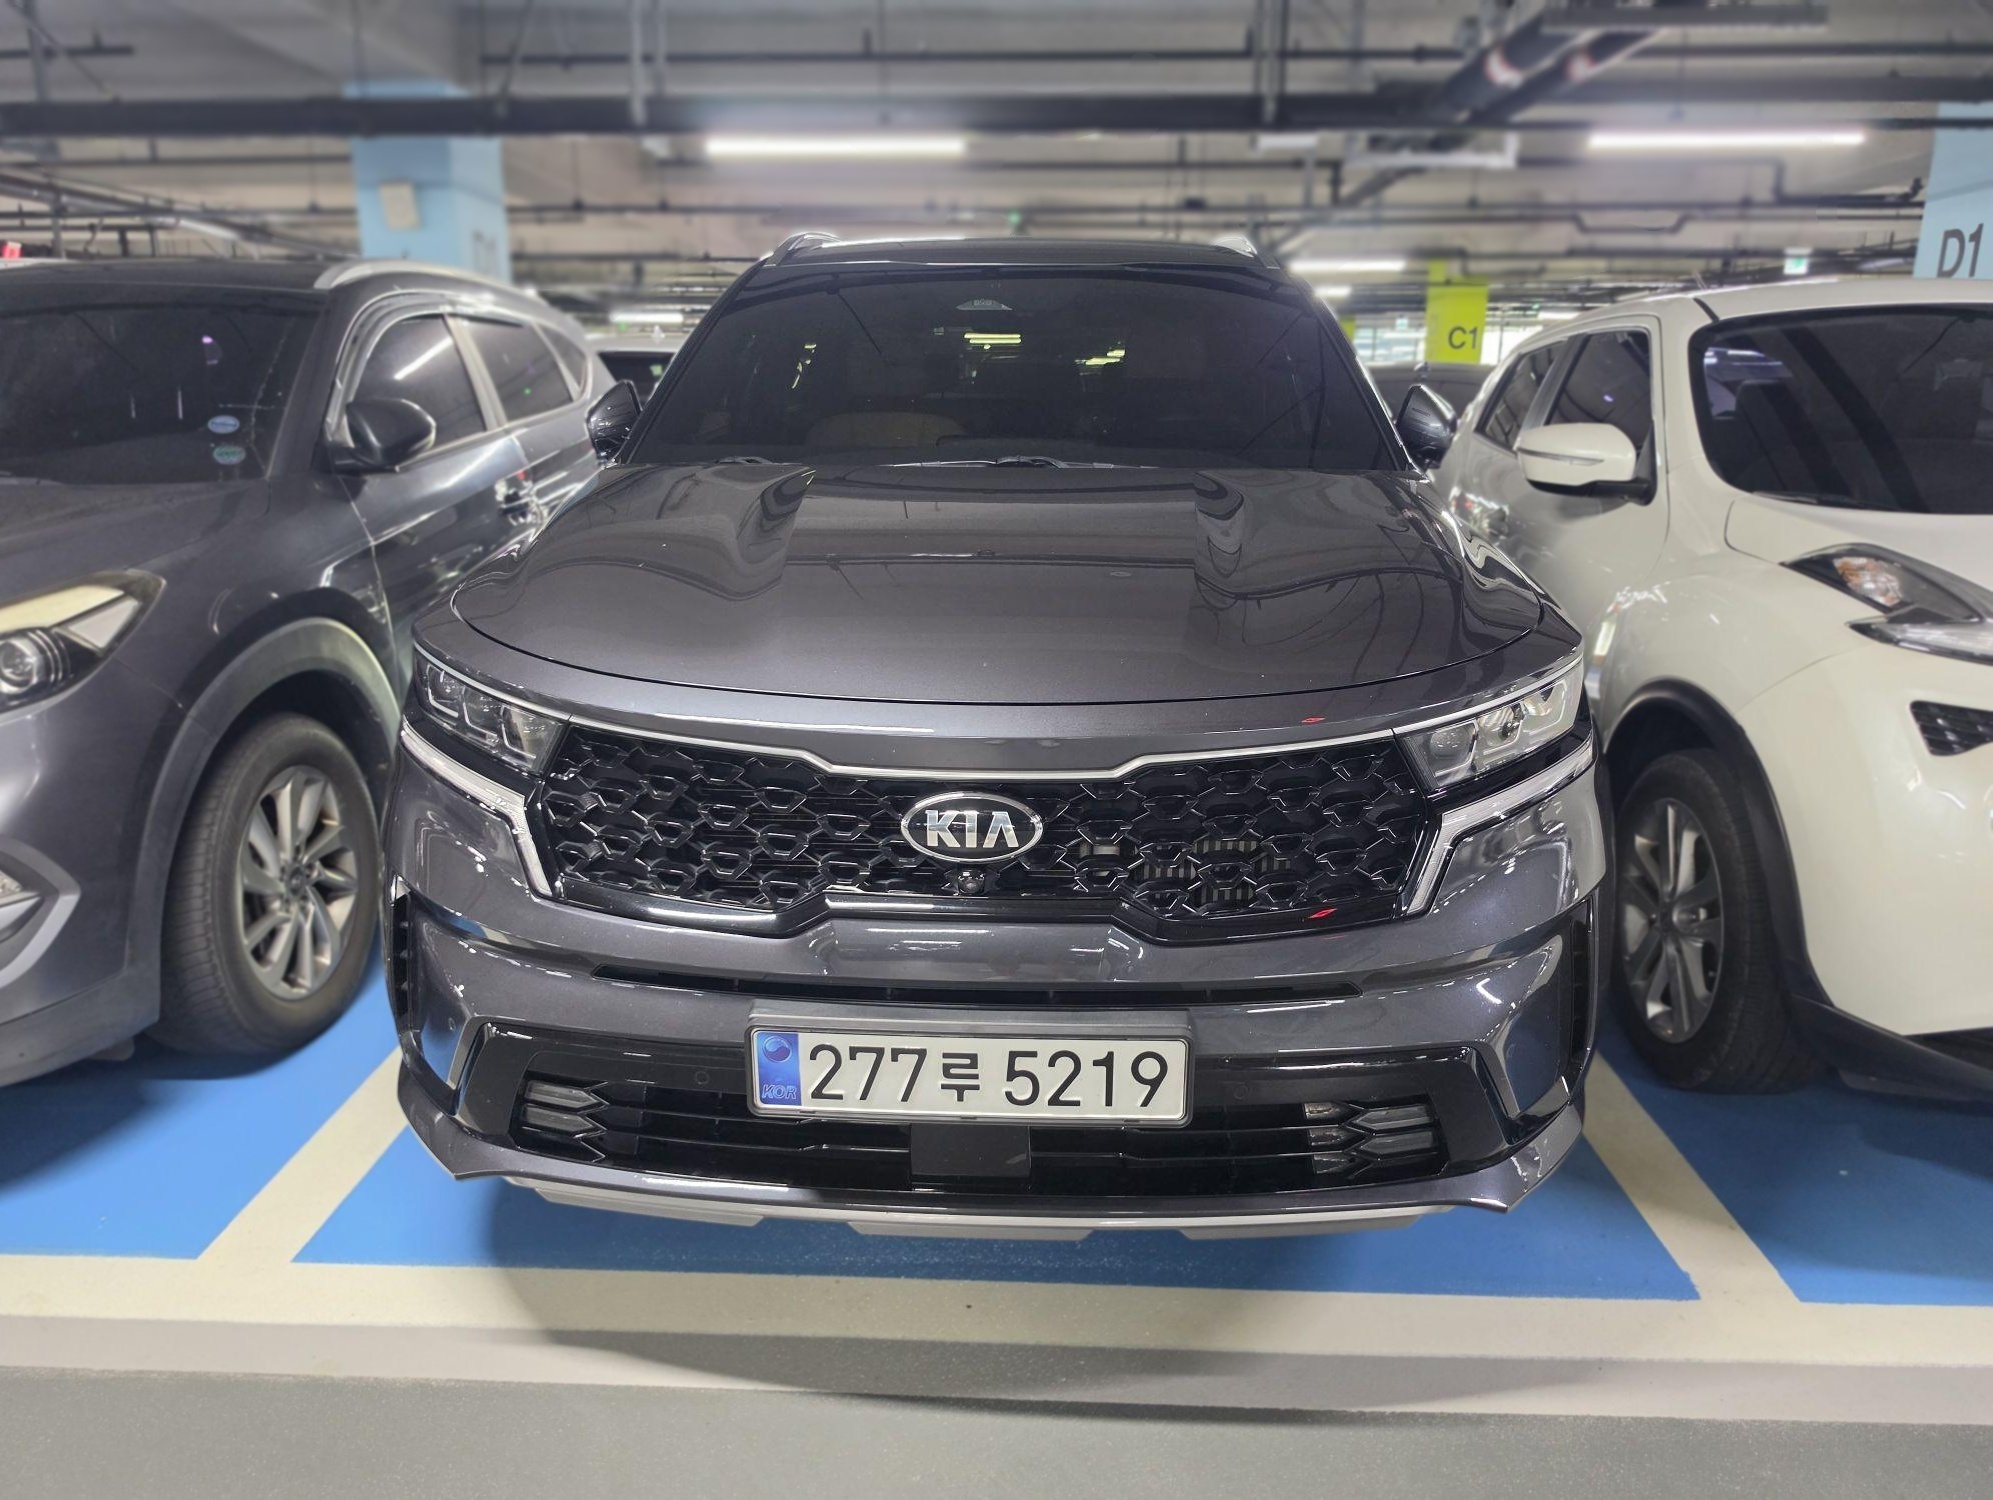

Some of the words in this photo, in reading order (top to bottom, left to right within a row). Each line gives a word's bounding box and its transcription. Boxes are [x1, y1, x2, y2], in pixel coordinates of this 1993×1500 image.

[1936, 223, 1984, 278] D1
[1448, 326, 1478, 350] C1
[925, 810, 1019, 848] KIA
[762, 1084, 797, 1099] KOR
[809, 1043, 981, 1103] 277루
[1004, 1049, 1168, 1108] 5219
